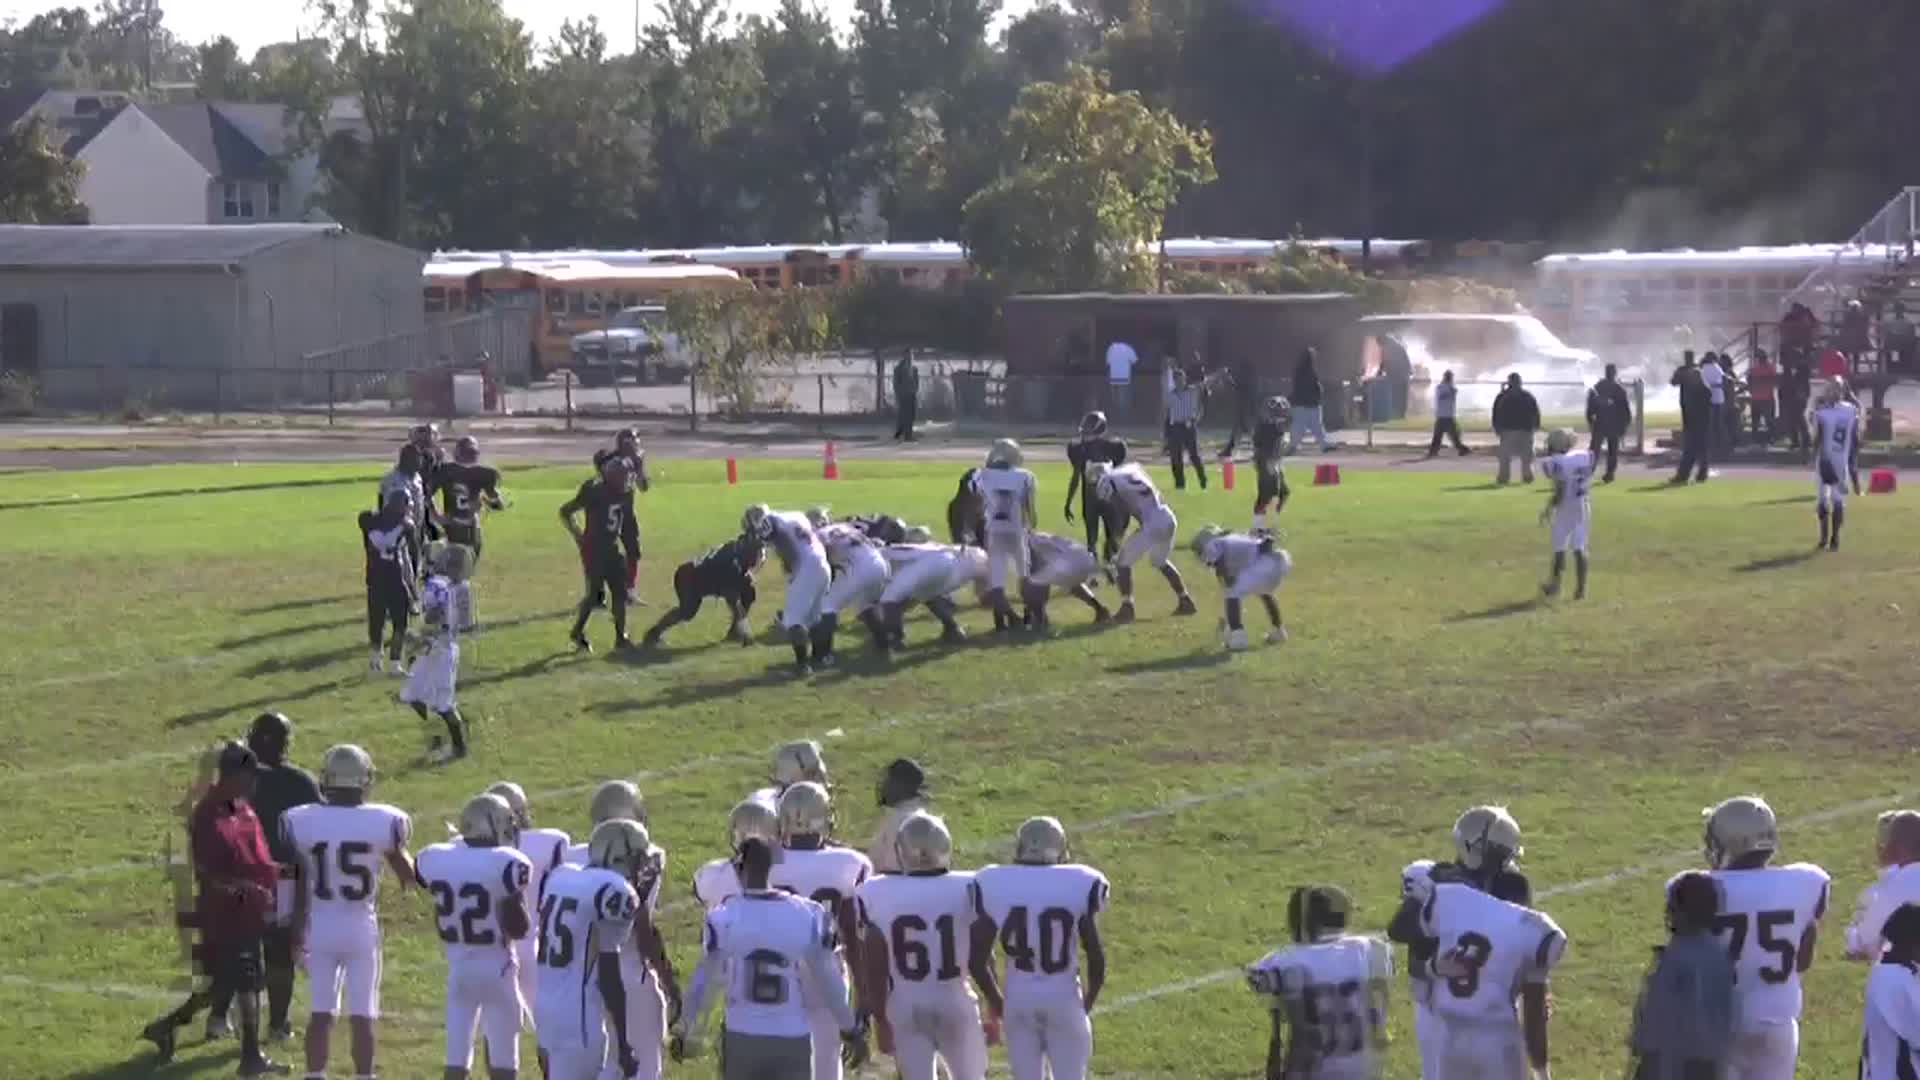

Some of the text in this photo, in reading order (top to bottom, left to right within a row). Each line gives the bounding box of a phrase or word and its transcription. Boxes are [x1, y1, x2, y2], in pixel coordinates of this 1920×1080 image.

[455, 482, 471, 510] 2
[311, 841, 374, 901] 15
[430, 880, 496, 945] 22
[1000, 906, 1075, 974] 40
[746, 947, 790, 1005] 6
[890, 913, 963, 982] 61
[1711, 909, 1795, 985] 75
